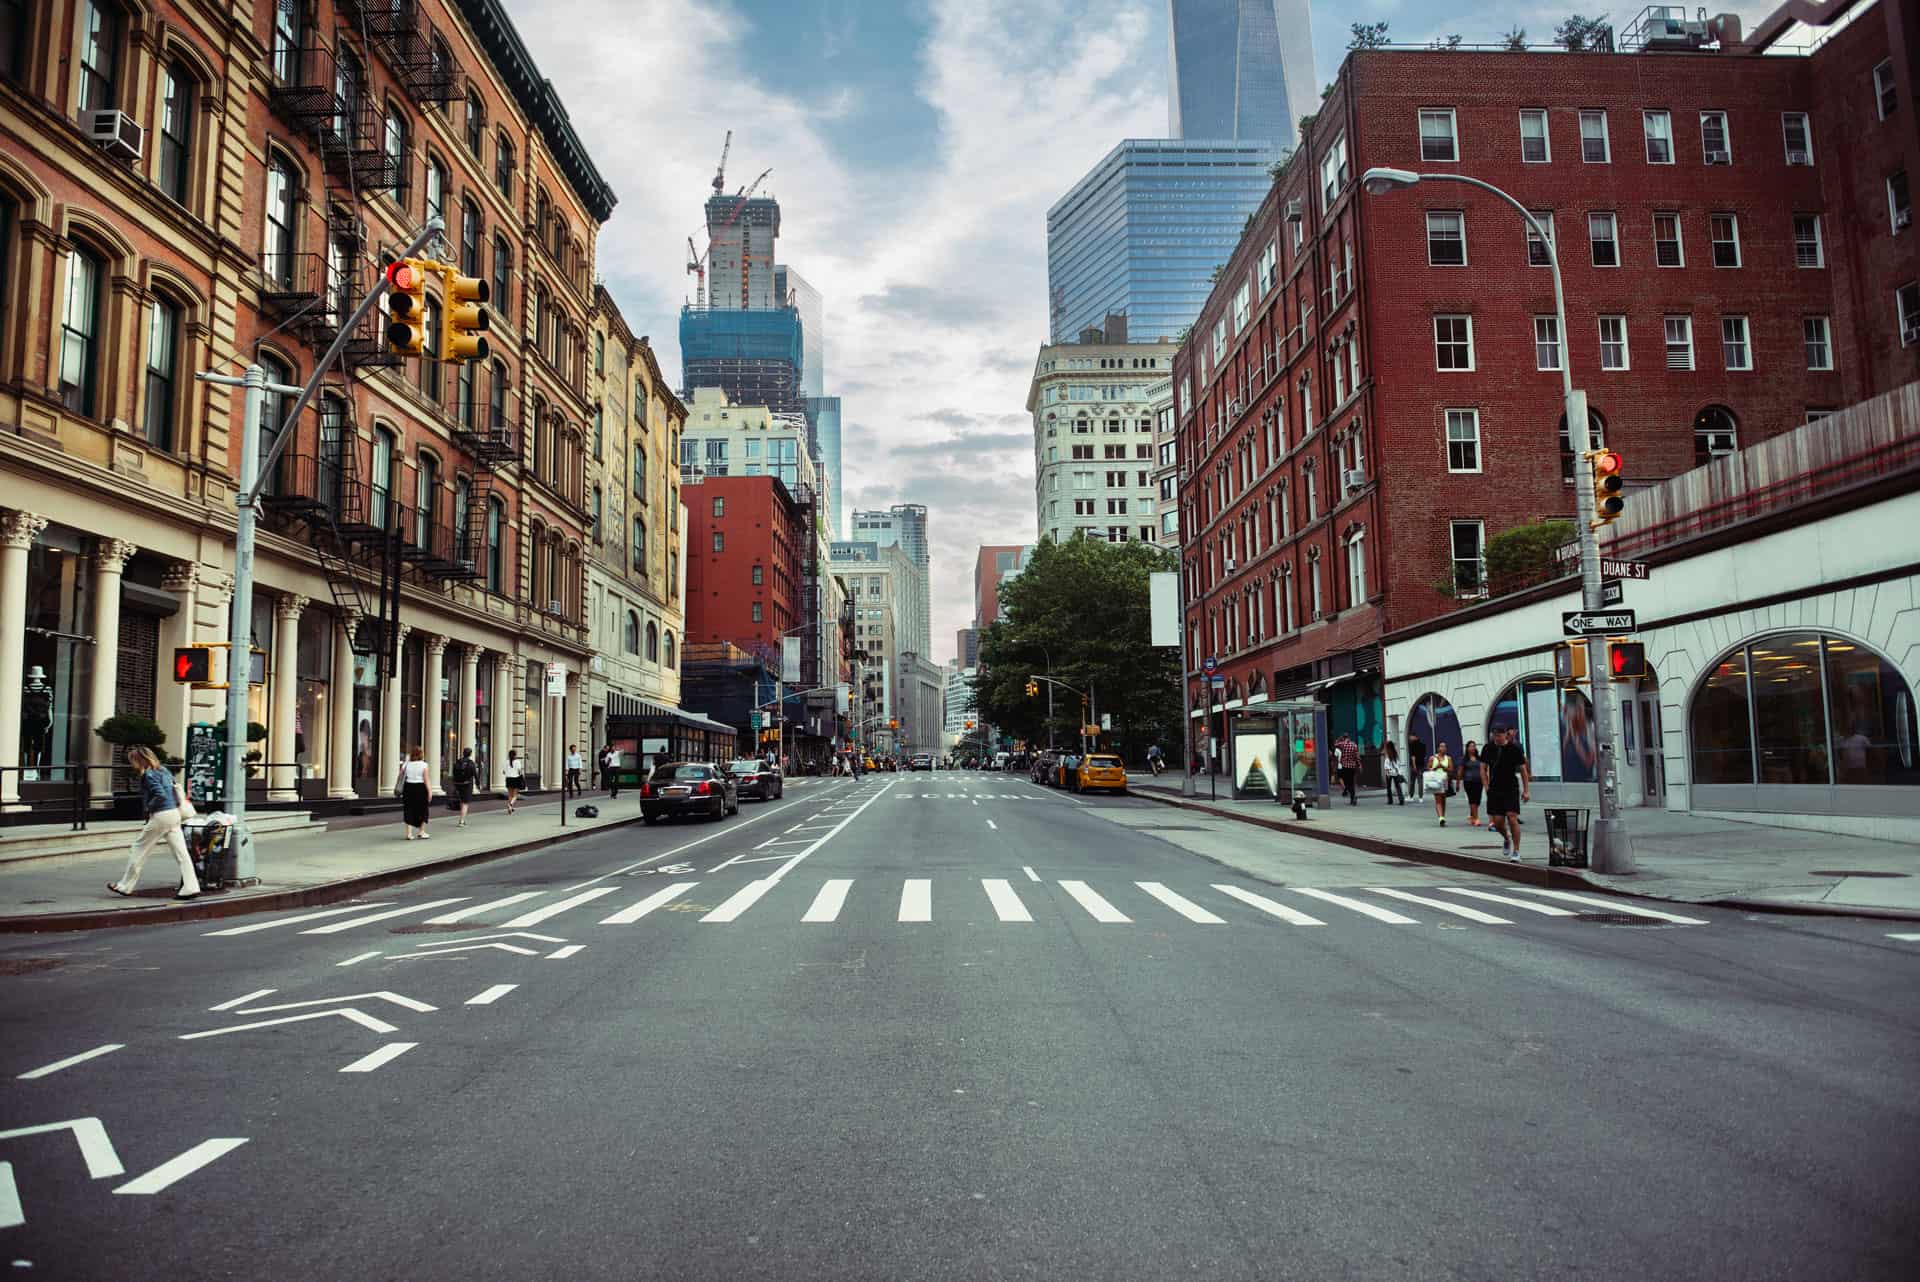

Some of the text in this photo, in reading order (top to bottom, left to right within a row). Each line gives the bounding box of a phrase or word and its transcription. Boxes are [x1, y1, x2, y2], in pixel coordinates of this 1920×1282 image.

[1603, 561, 1646, 577] DUANE ST
[1572, 616, 1629, 628] ONE WAY
